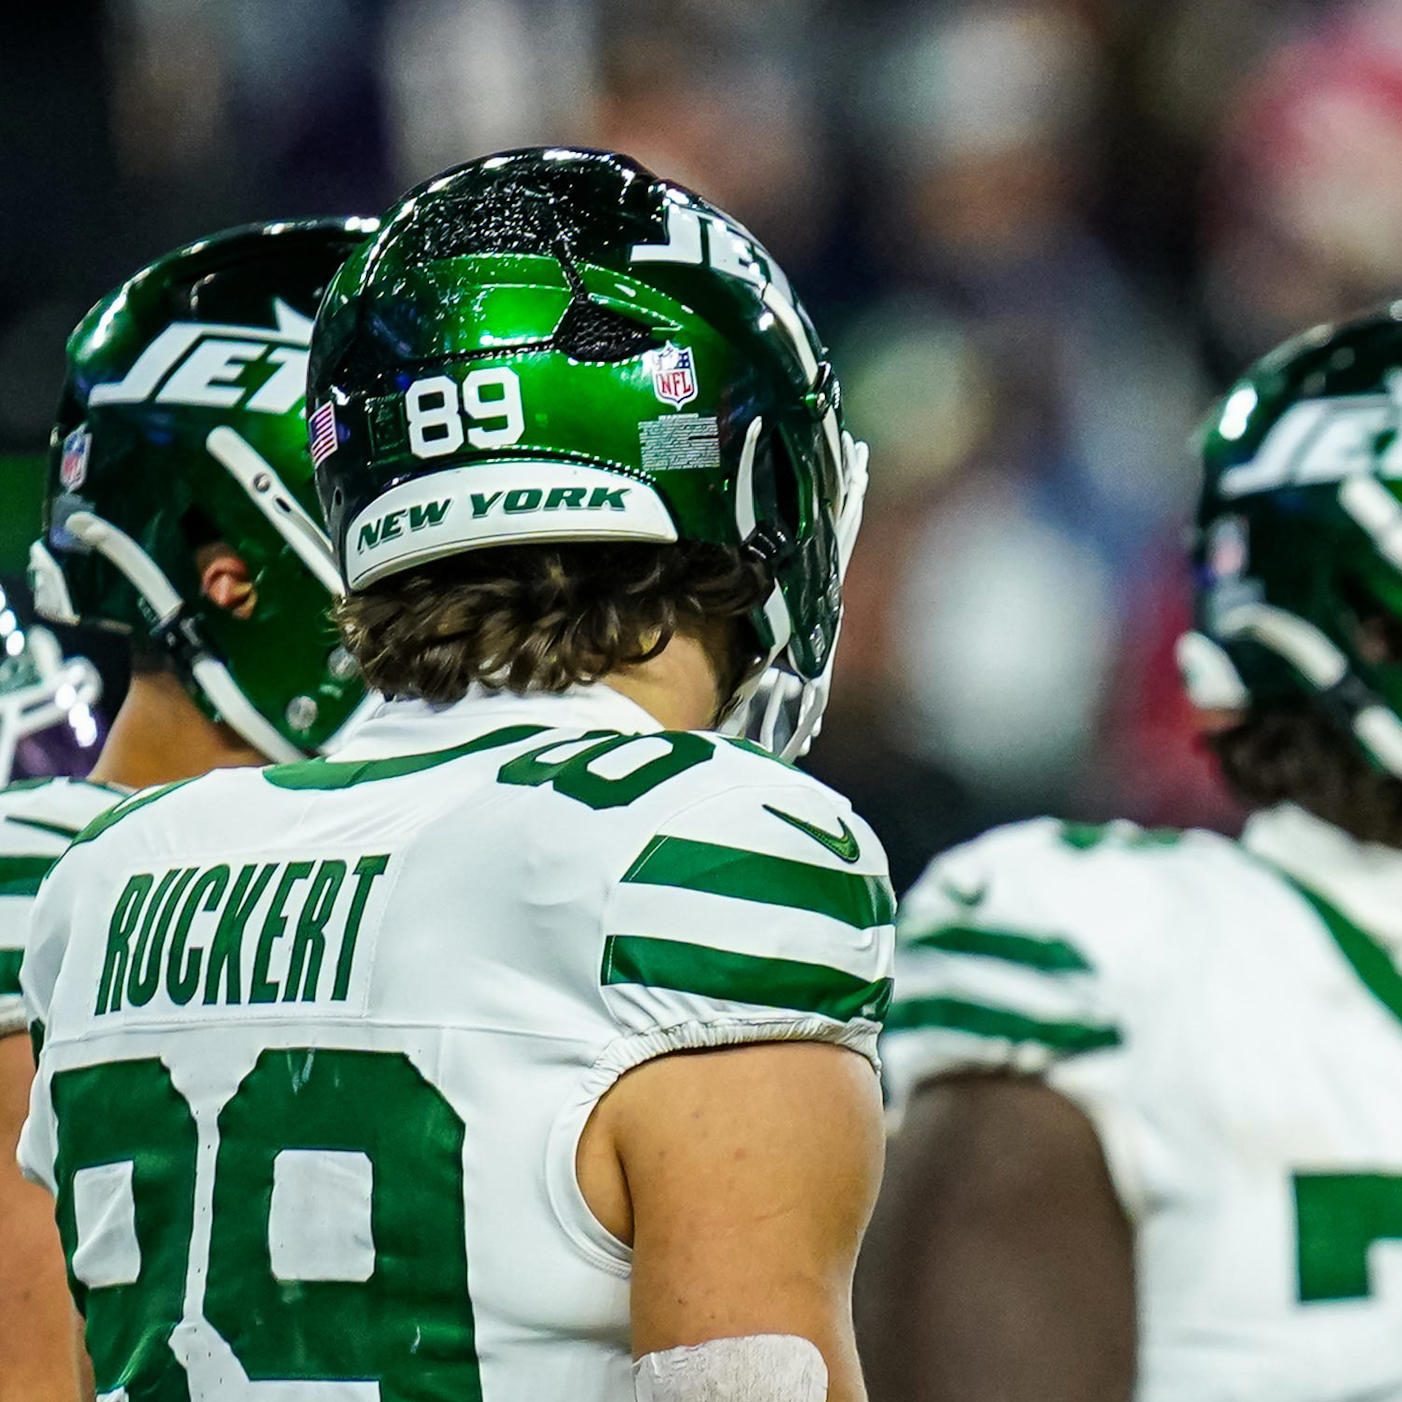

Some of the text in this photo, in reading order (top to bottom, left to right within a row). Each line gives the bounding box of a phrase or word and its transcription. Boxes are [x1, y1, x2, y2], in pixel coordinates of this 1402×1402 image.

[88, 297, 316, 416] JET
[658, 371, 692, 397] NFL
[405, 366, 525, 459] 89
[356, 487, 632, 553] NEW YORK
[94, 853, 391, 1017] RUCKERT
